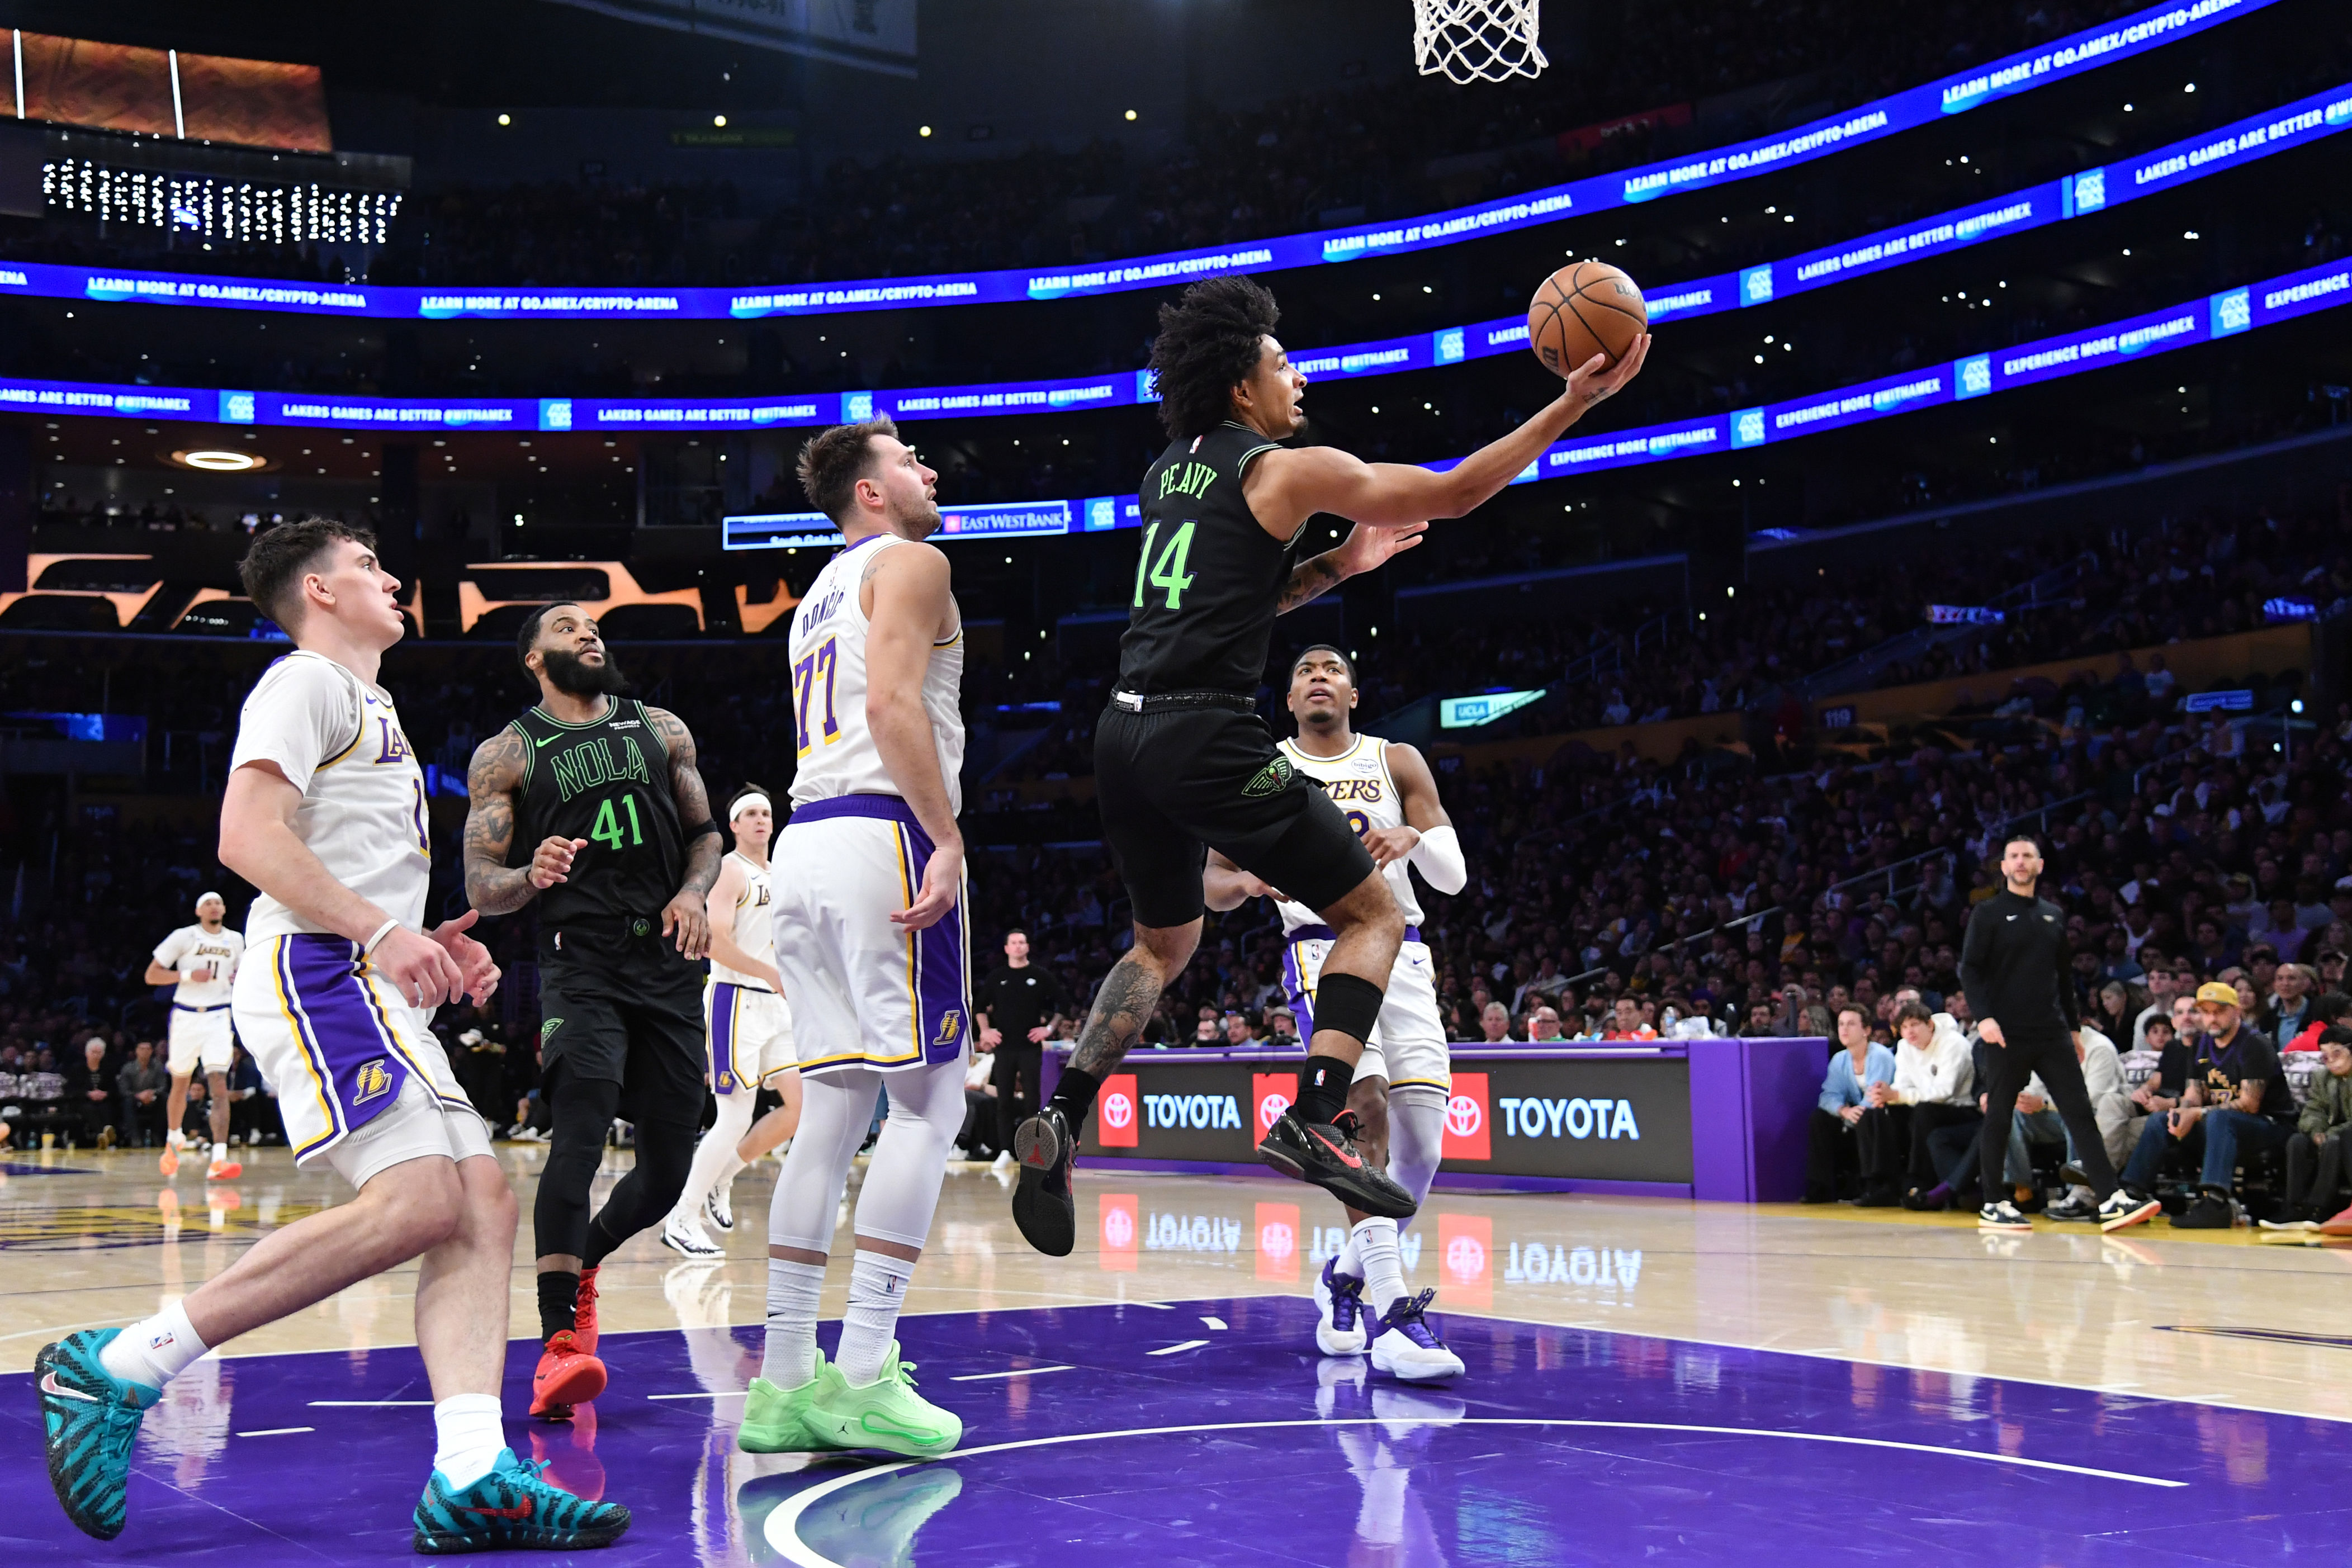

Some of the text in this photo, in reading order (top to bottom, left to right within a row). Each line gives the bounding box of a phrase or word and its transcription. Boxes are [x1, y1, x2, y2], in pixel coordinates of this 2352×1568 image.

[1943, 77, 1988, 104] LEARN
[1990, 62, 2031, 88] MORE
[2033, 55, 2052, 75] AT
[2136, 155, 2187, 184] LAKERS
[2189, 138, 2236, 166] GAMES
[2239, 127, 2266, 150] ARE
[2269, 110, 2322, 140] BETTER
[1625, 172, 1668, 193] LEARN
[1670, 163, 1707, 183] MORE
[1709, 158, 1726, 175] AT
[1324, 236, 1365, 253] LEARN
[1367, 230, 1404, 247] MORE
[1405, 227, 1421, 242] AT
[1798, 257, 1841, 281] LAKERS
[1842, 245, 1882, 268] GAMES
[1884, 238, 1907, 257] ARE
[1909, 225, 1953, 249] BETTER
[88, 277, 134, 292] LEARN
[137, 281, 177, 295] MORE
[178, 283, 196, 296] AT
[1029, 276, 1070, 291] LEARN
[1072, 272, 1106, 287] MORE
[1107, 270, 1123, 283] AT
[2265, 273, 2349, 309] EXPERIENCE
[422, 297, 463, 309] LEARN
[465, 297, 501, 309] MORE
[503, 297, 520, 309] AT
[732, 296, 772, 310] LEARN
[774, 293, 808, 307] MORE
[809, 292, 825, 305] AT
[1298, 358, 1340, 374] BETTER
[2004, 345, 2079, 375] EXPERIENCE
[2081, 337, 2117, 357] MORE
[0, 389, 36, 402] AMES
[36, 391, 64, 404] ARE
[65, 392, 113, 406] BETTER
[283, 404, 329, 418] LAKERS
[331, 407, 373, 420] GAMES
[374, 409, 397, 420] ARE
[399, 409, 442, 421] BETTER
[898, 398, 940, 411] LAKERS
[941, 396, 980, 409] GAMES
[981, 394, 1004, 406] ARE
[1005, 392, 1047, 405] BETTER
[1776, 402, 1839, 428] EXPERIENCE
[1841, 394, 1871, 413] MORE
[598, 409, 642, 421] LAKERS
[643, 409, 683, 421] GAMES
[685, 409, 707, 421] ARE
[709, 409, 750, 420] BETTER
[1550, 444, 1614, 466] EXPERIENCE
[1616, 439, 1647, 455] MORE
[1159, 462, 1218, 500] PEAVY
[1133, 519, 1197, 610] 14
[793, 633, 841, 760] 77
[1458, 703, 1486, 718] UCLA
[551, 736, 649, 802] NOLA
[413, 776, 430, 859] 1
[591, 794, 643, 850] 41
[1143, 1095, 1242, 1129] TOYOTA
[1499, 1097, 1640, 1140] TOYOTA
